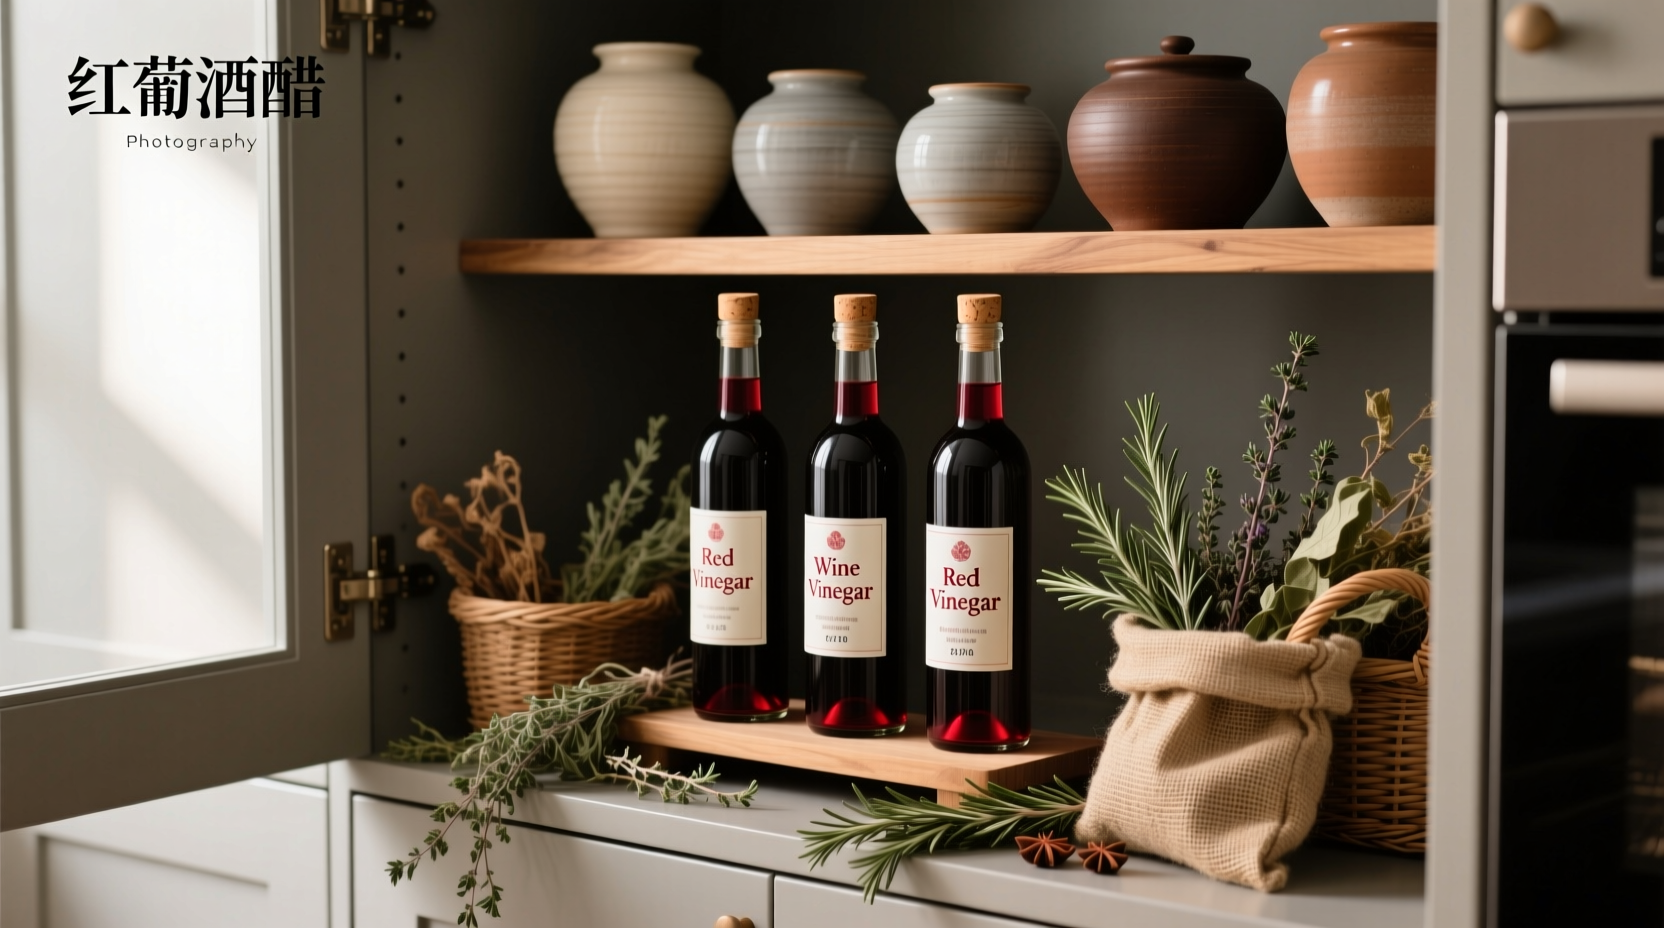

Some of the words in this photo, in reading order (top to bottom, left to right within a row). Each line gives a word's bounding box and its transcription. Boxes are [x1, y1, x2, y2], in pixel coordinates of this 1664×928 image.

[702, 547, 734, 567] Red
[813, 556, 861, 577] Wine
[692, 568, 754, 596] Vinegar
[943, 566, 981, 588] Red
[808, 578, 874, 606] Vinegar
[929, 588, 1002, 617] Vinegar
